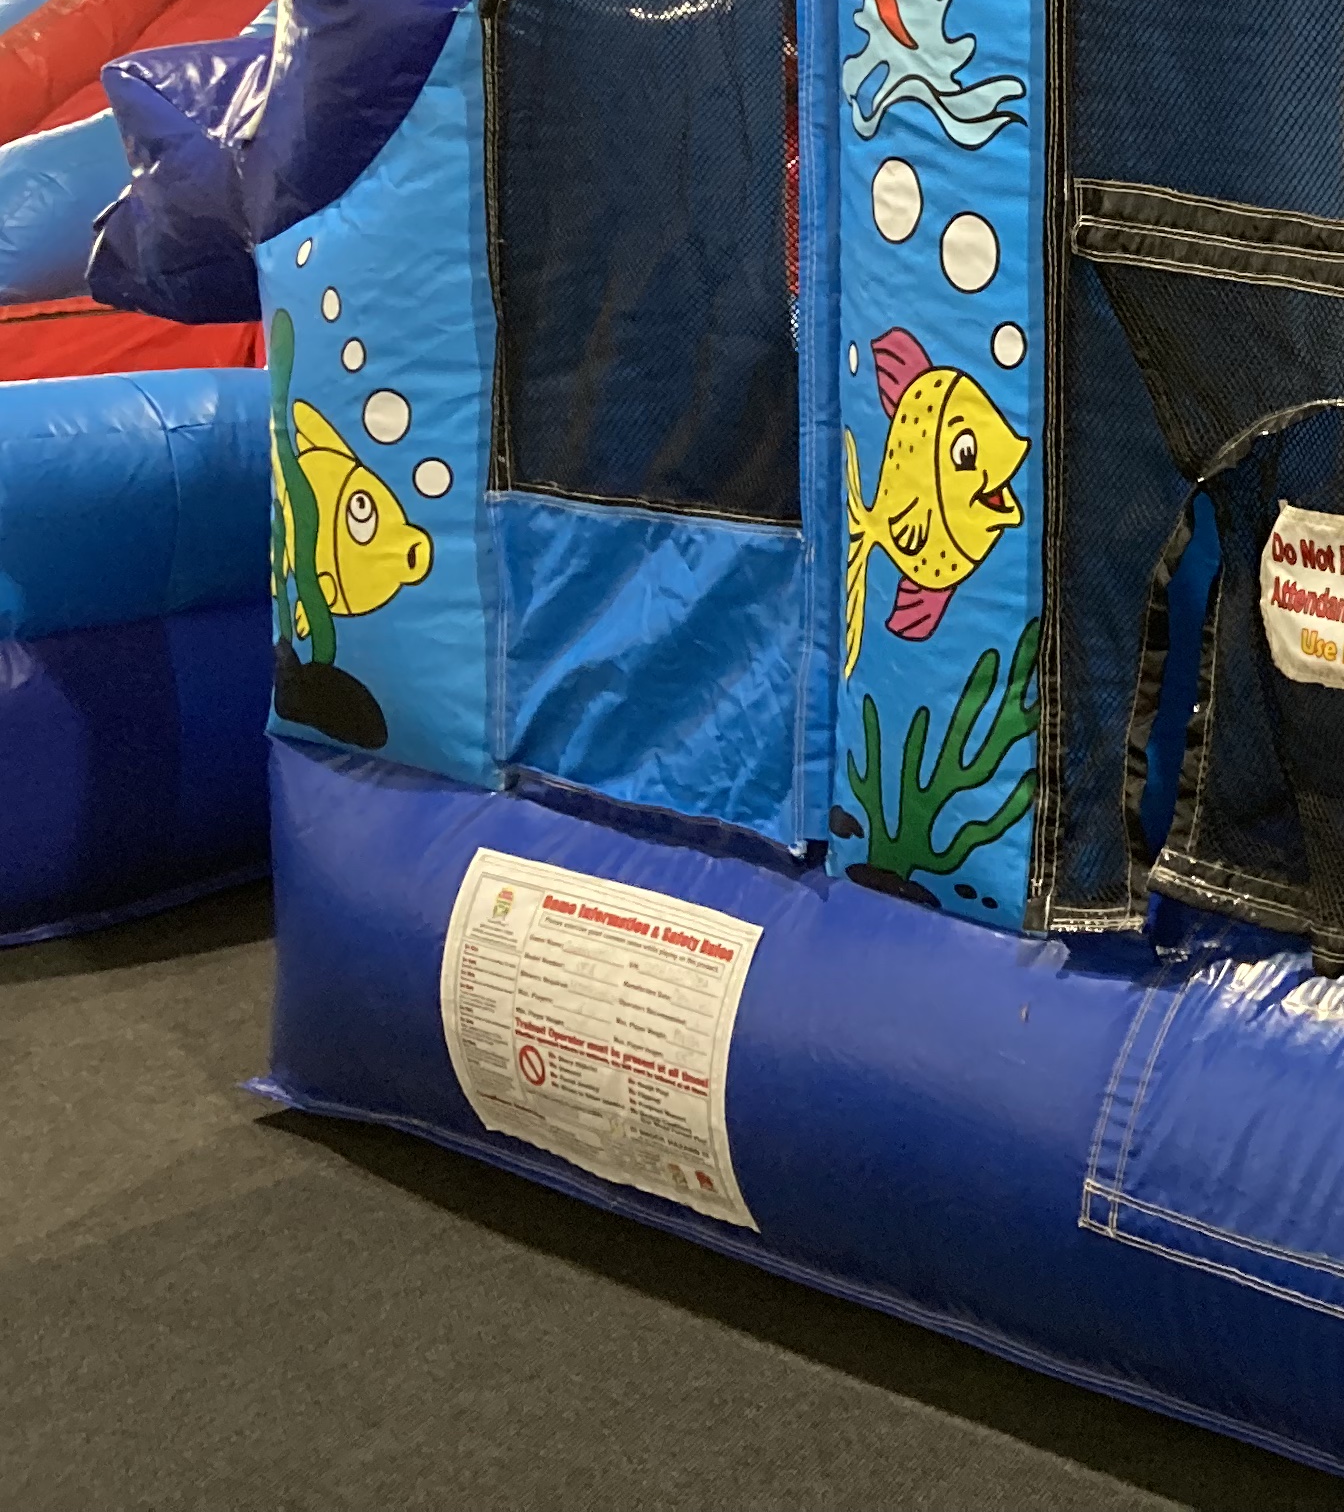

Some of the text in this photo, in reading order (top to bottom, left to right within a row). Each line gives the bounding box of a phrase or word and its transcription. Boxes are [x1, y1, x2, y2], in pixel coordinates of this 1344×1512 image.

[1272, 532, 1297, 565] Do
[1300, 539, 1335, 573] Not
[1300, 628, 1337, 661] Use
